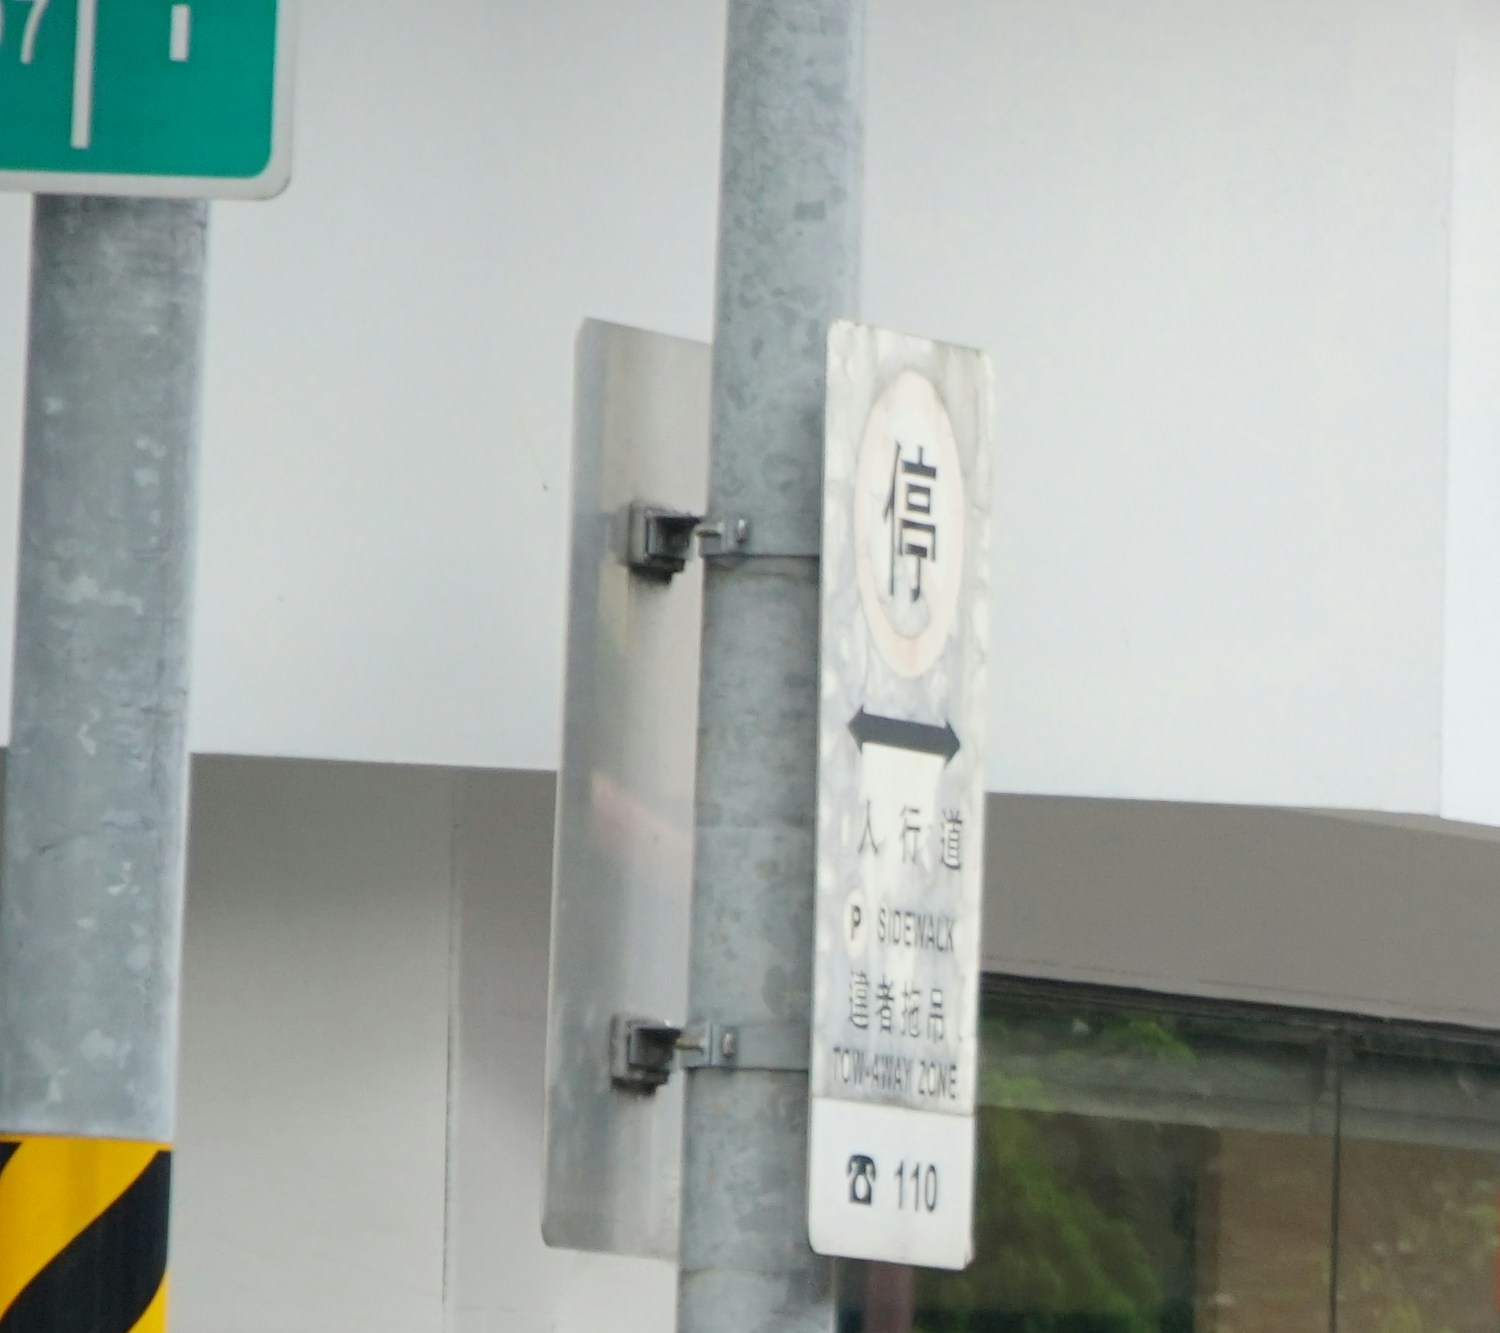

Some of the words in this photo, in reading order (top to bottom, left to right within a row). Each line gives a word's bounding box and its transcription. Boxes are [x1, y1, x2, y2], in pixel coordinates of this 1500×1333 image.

[883, 440, 937, 602] 停
[857, 798, 964, 871] 人行道
[848, 970, 945, 1043] 違者拖吊
[918, 1060, 958, 1101] ZONE
[894, 1160, 938, 1214] 110
